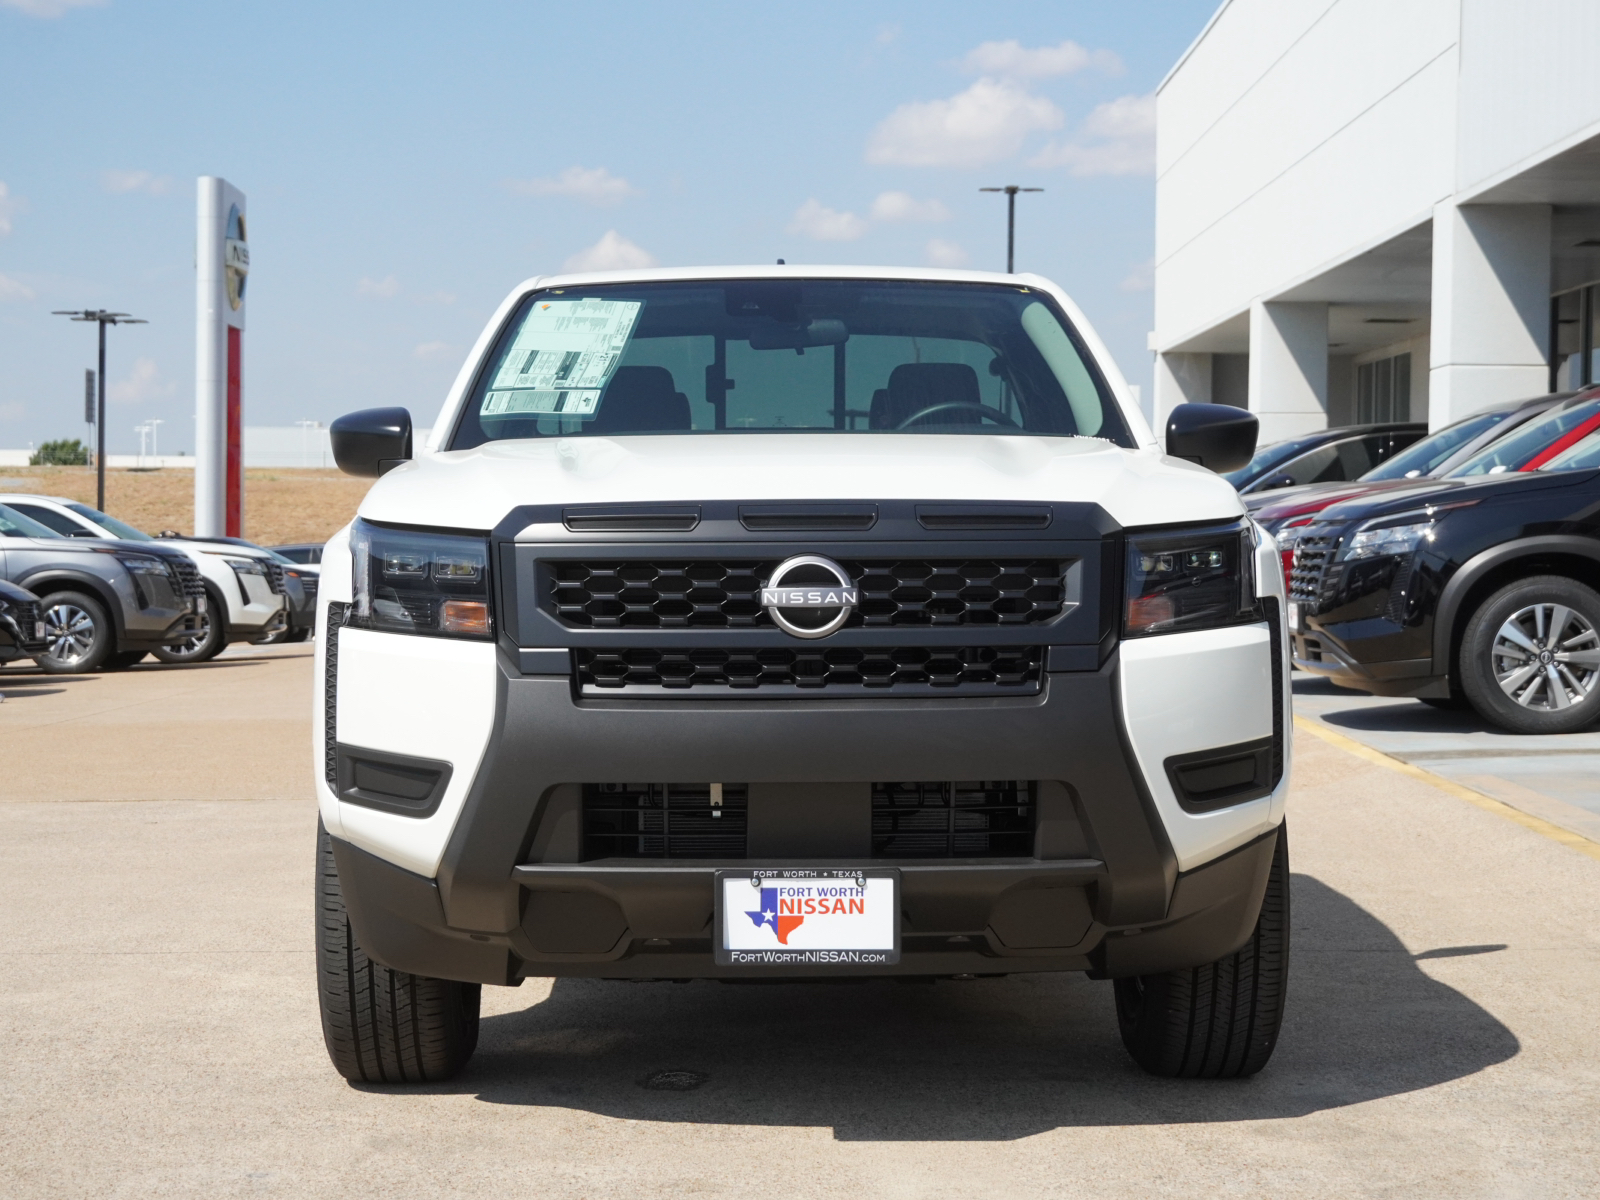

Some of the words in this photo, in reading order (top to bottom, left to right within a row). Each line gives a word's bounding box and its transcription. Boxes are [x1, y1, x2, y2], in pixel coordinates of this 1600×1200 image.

[764, 592, 856, 603] NISSAN
[753, 870, 778, 878] FORT
[783, 870, 817, 878] WORTH
[832, 870, 863, 878] TEXAS
[779, 887, 813, 897] FORT
[816, 887, 864, 897] WORTH
[779, 898, 864, 914] NISSAN
